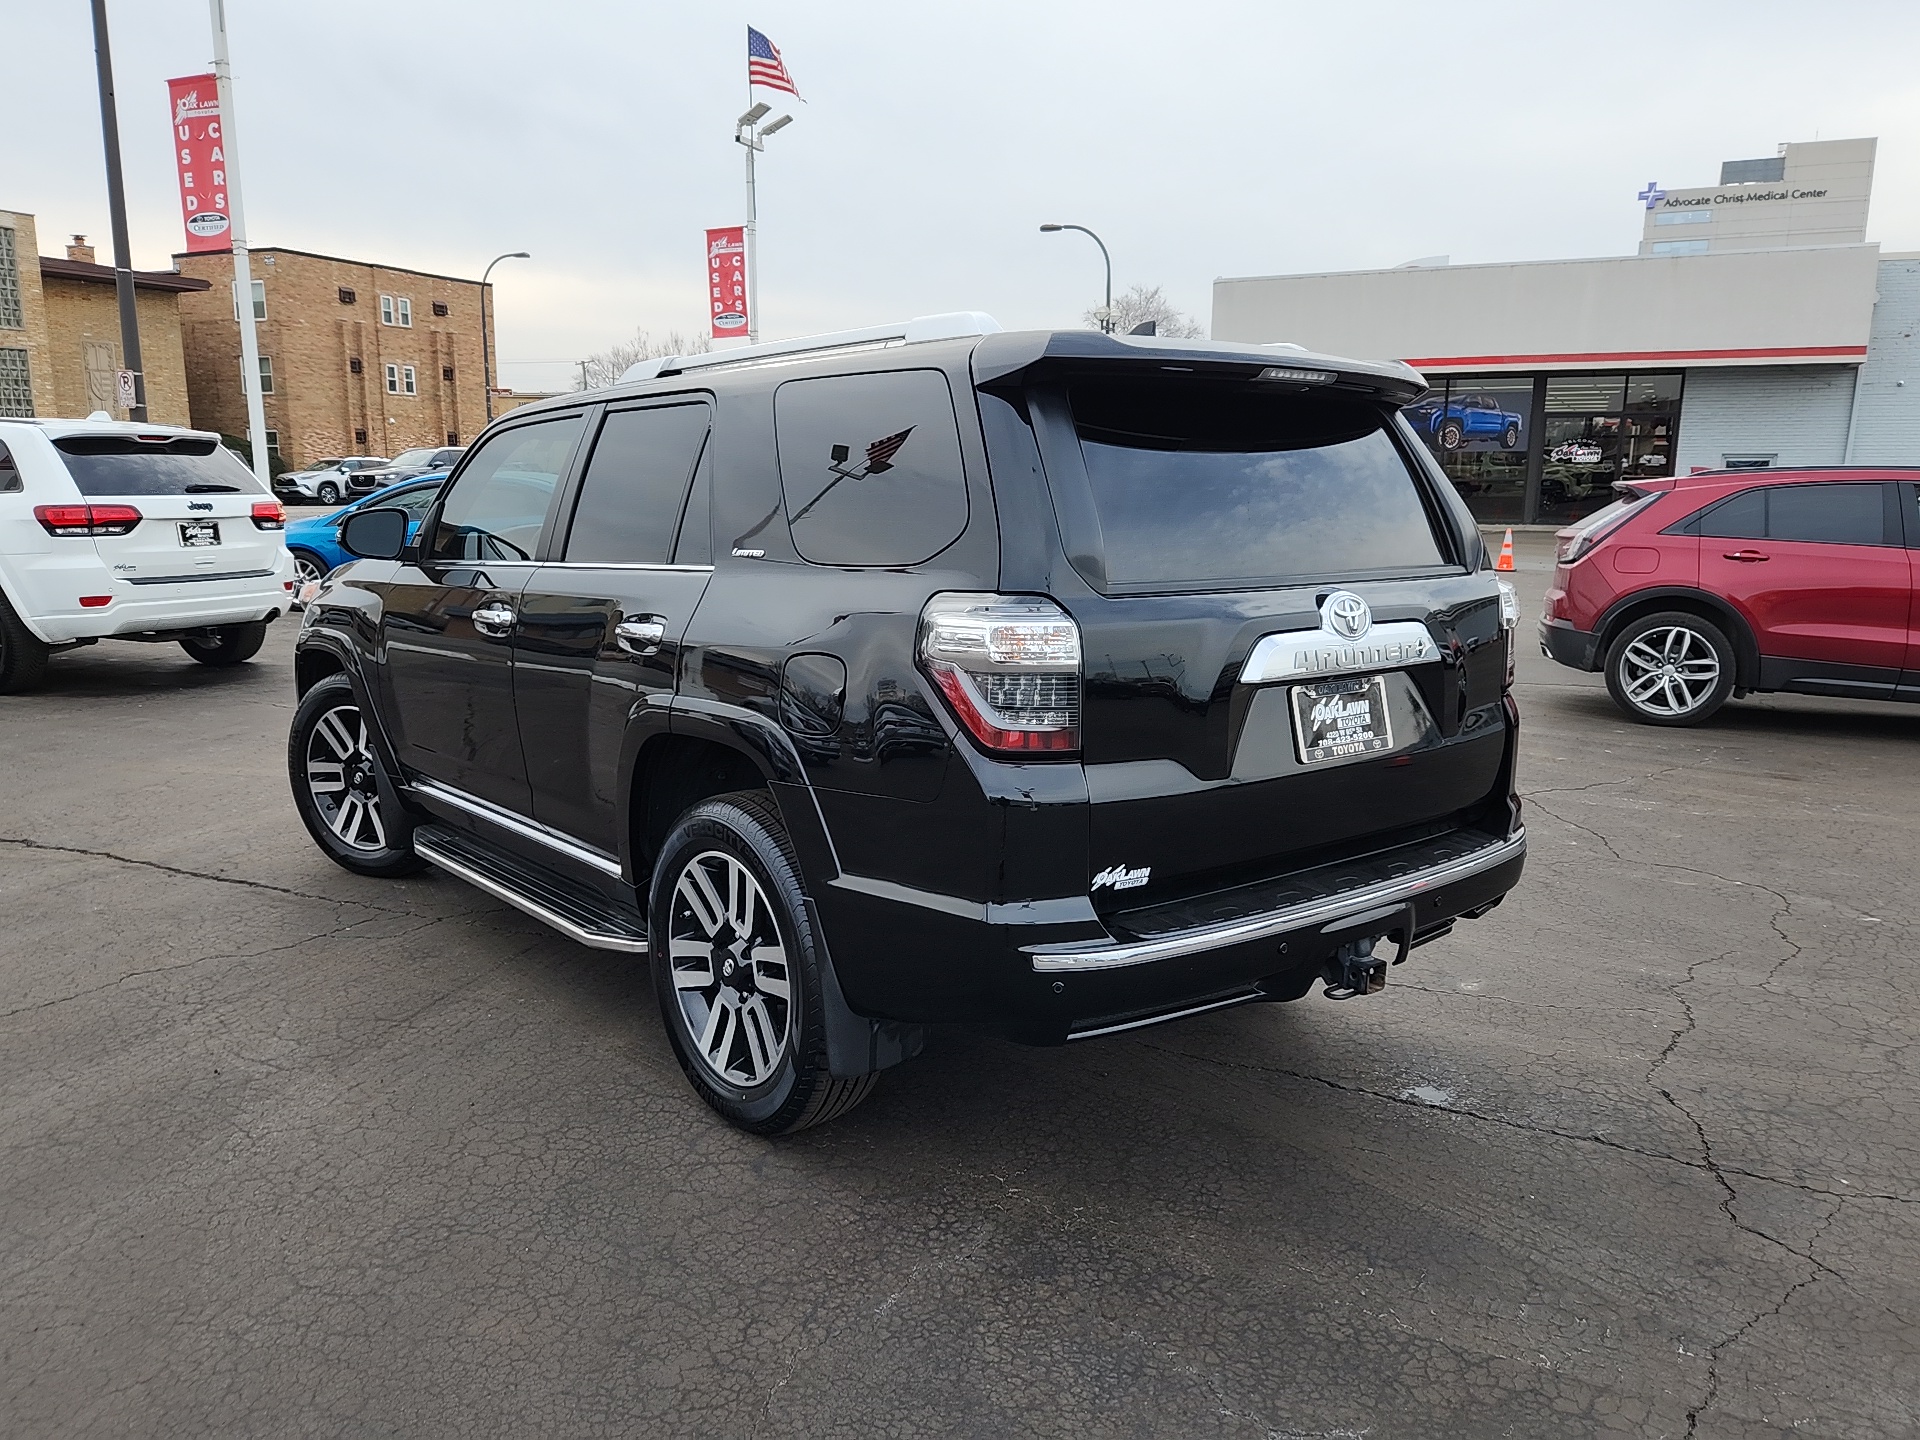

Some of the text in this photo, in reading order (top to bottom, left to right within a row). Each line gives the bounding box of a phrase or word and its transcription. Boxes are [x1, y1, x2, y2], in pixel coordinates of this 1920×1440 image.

[199, 100, 219, 108] LAWN
[178, 124, 198, 211] USED
[207, 122, 226, 209] CARS
[1663, 189, 1828, 208] Advocate Christ Medical Center
[711, 257, 723, 312] USED
[732, 256, 744, 311] CARS
[187, 500, 213, 512] Jeep
[1340, 715, 1367, 728] TOYOTA
[1332, 742, 1366, 756] TOYOTA
